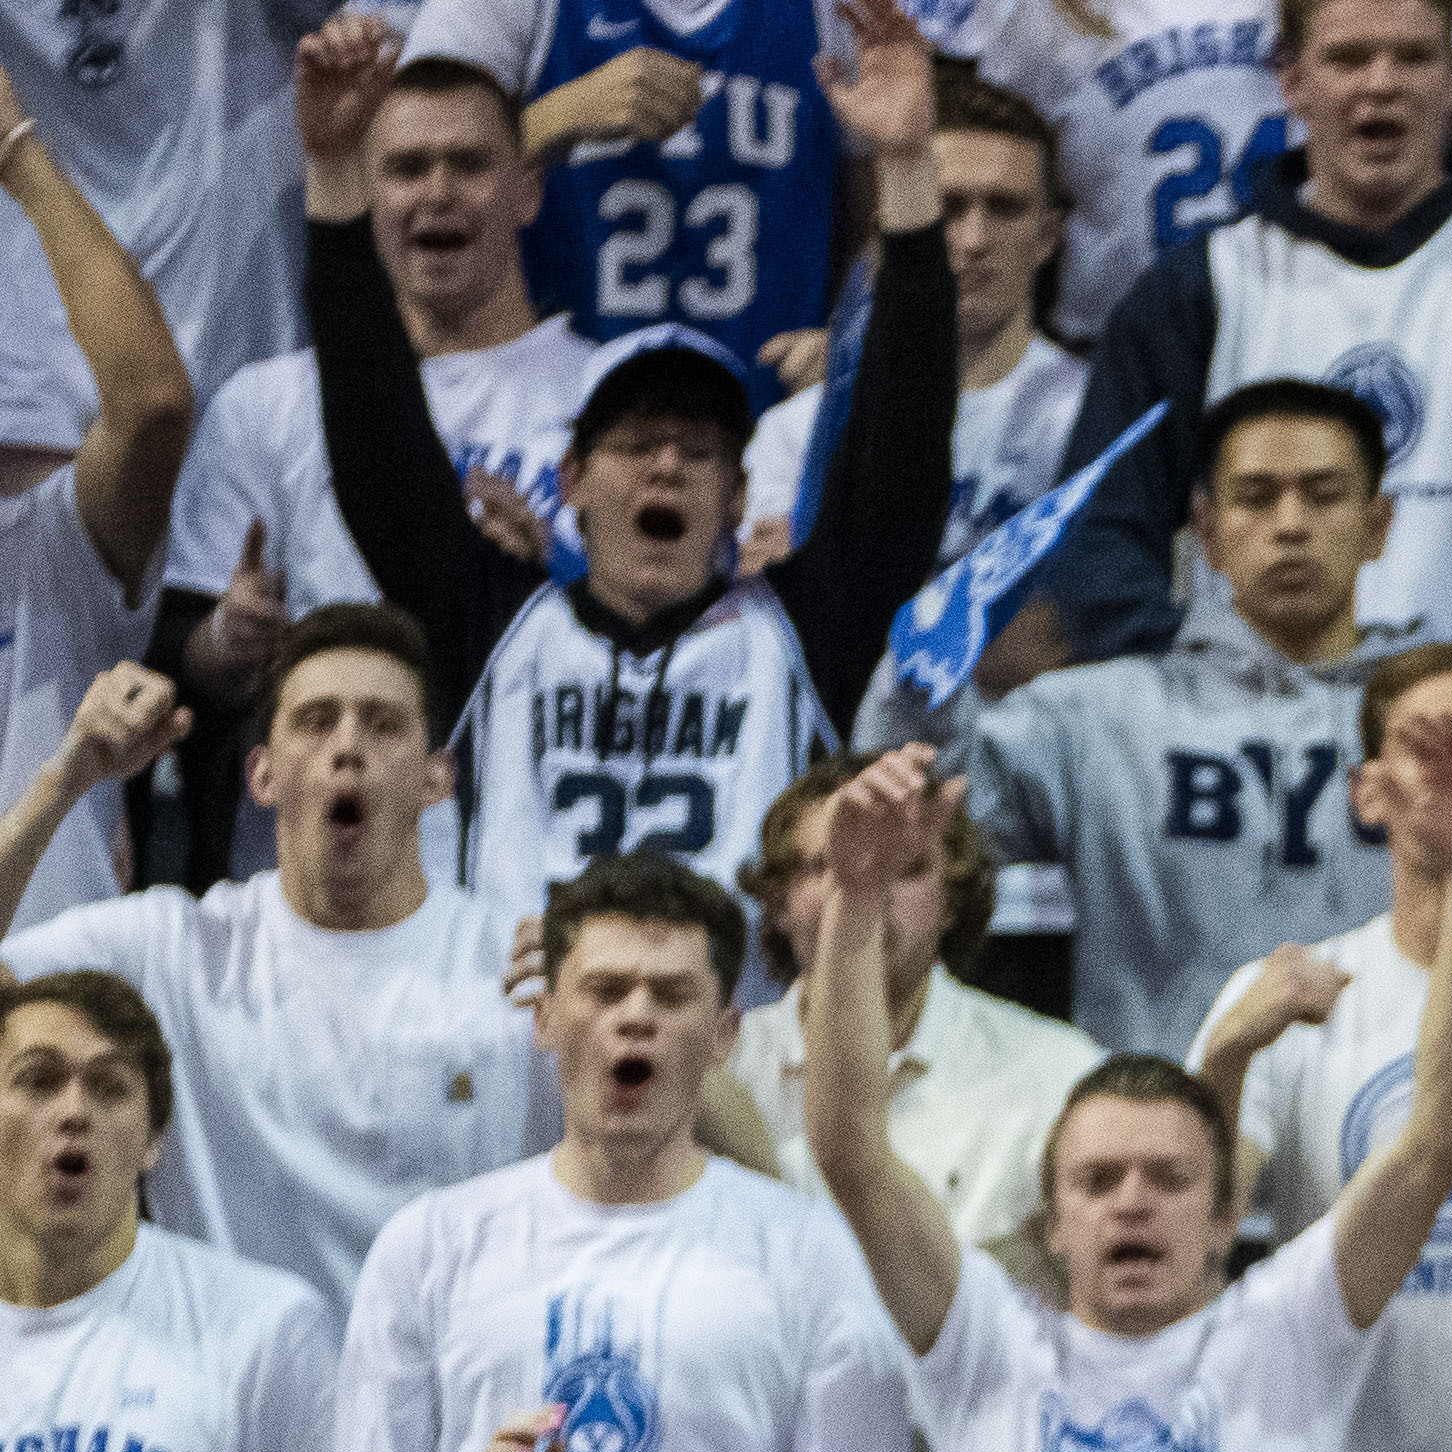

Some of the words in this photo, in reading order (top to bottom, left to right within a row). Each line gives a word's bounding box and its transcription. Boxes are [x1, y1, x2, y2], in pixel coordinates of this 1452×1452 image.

[1096, 19, 1268, 110] BRIGH
[596, 177, 761, 320] 23
[1162, 739, 1389, 870] BY
